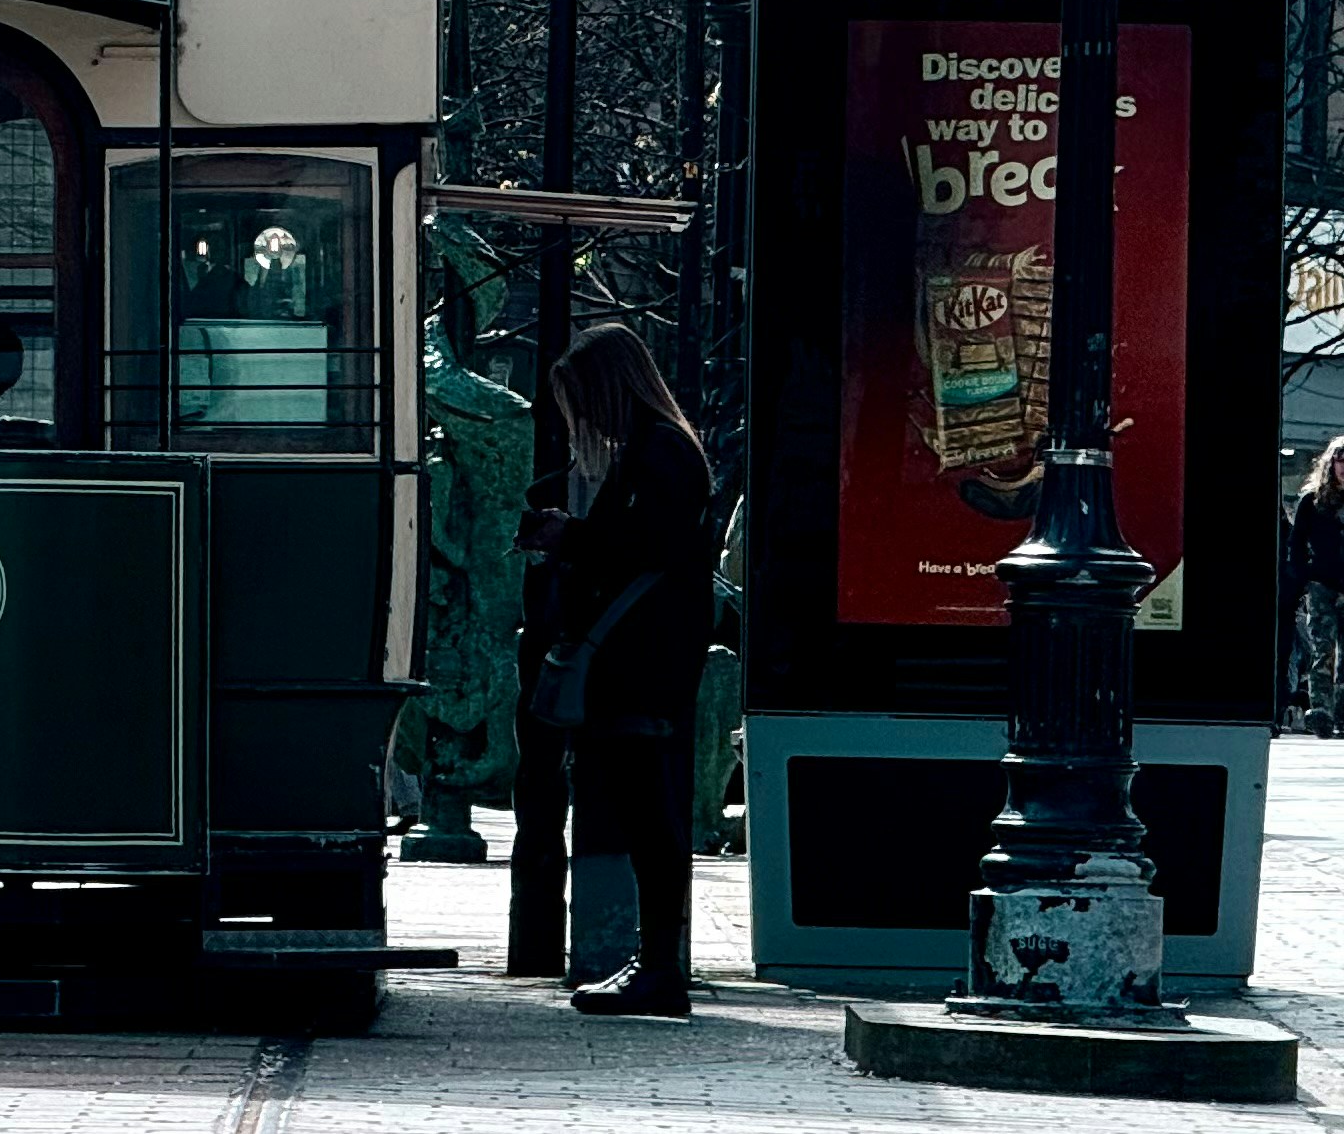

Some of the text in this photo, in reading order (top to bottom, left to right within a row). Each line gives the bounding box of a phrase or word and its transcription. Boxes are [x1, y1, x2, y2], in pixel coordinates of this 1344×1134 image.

[922, 52, 1061, 82] Discove
[970, 82, 1137, 118] delics
[926, 114, 1048, 147] way to
[918, 560, 951, 574] Have
[953, 565, 962, 574] a
